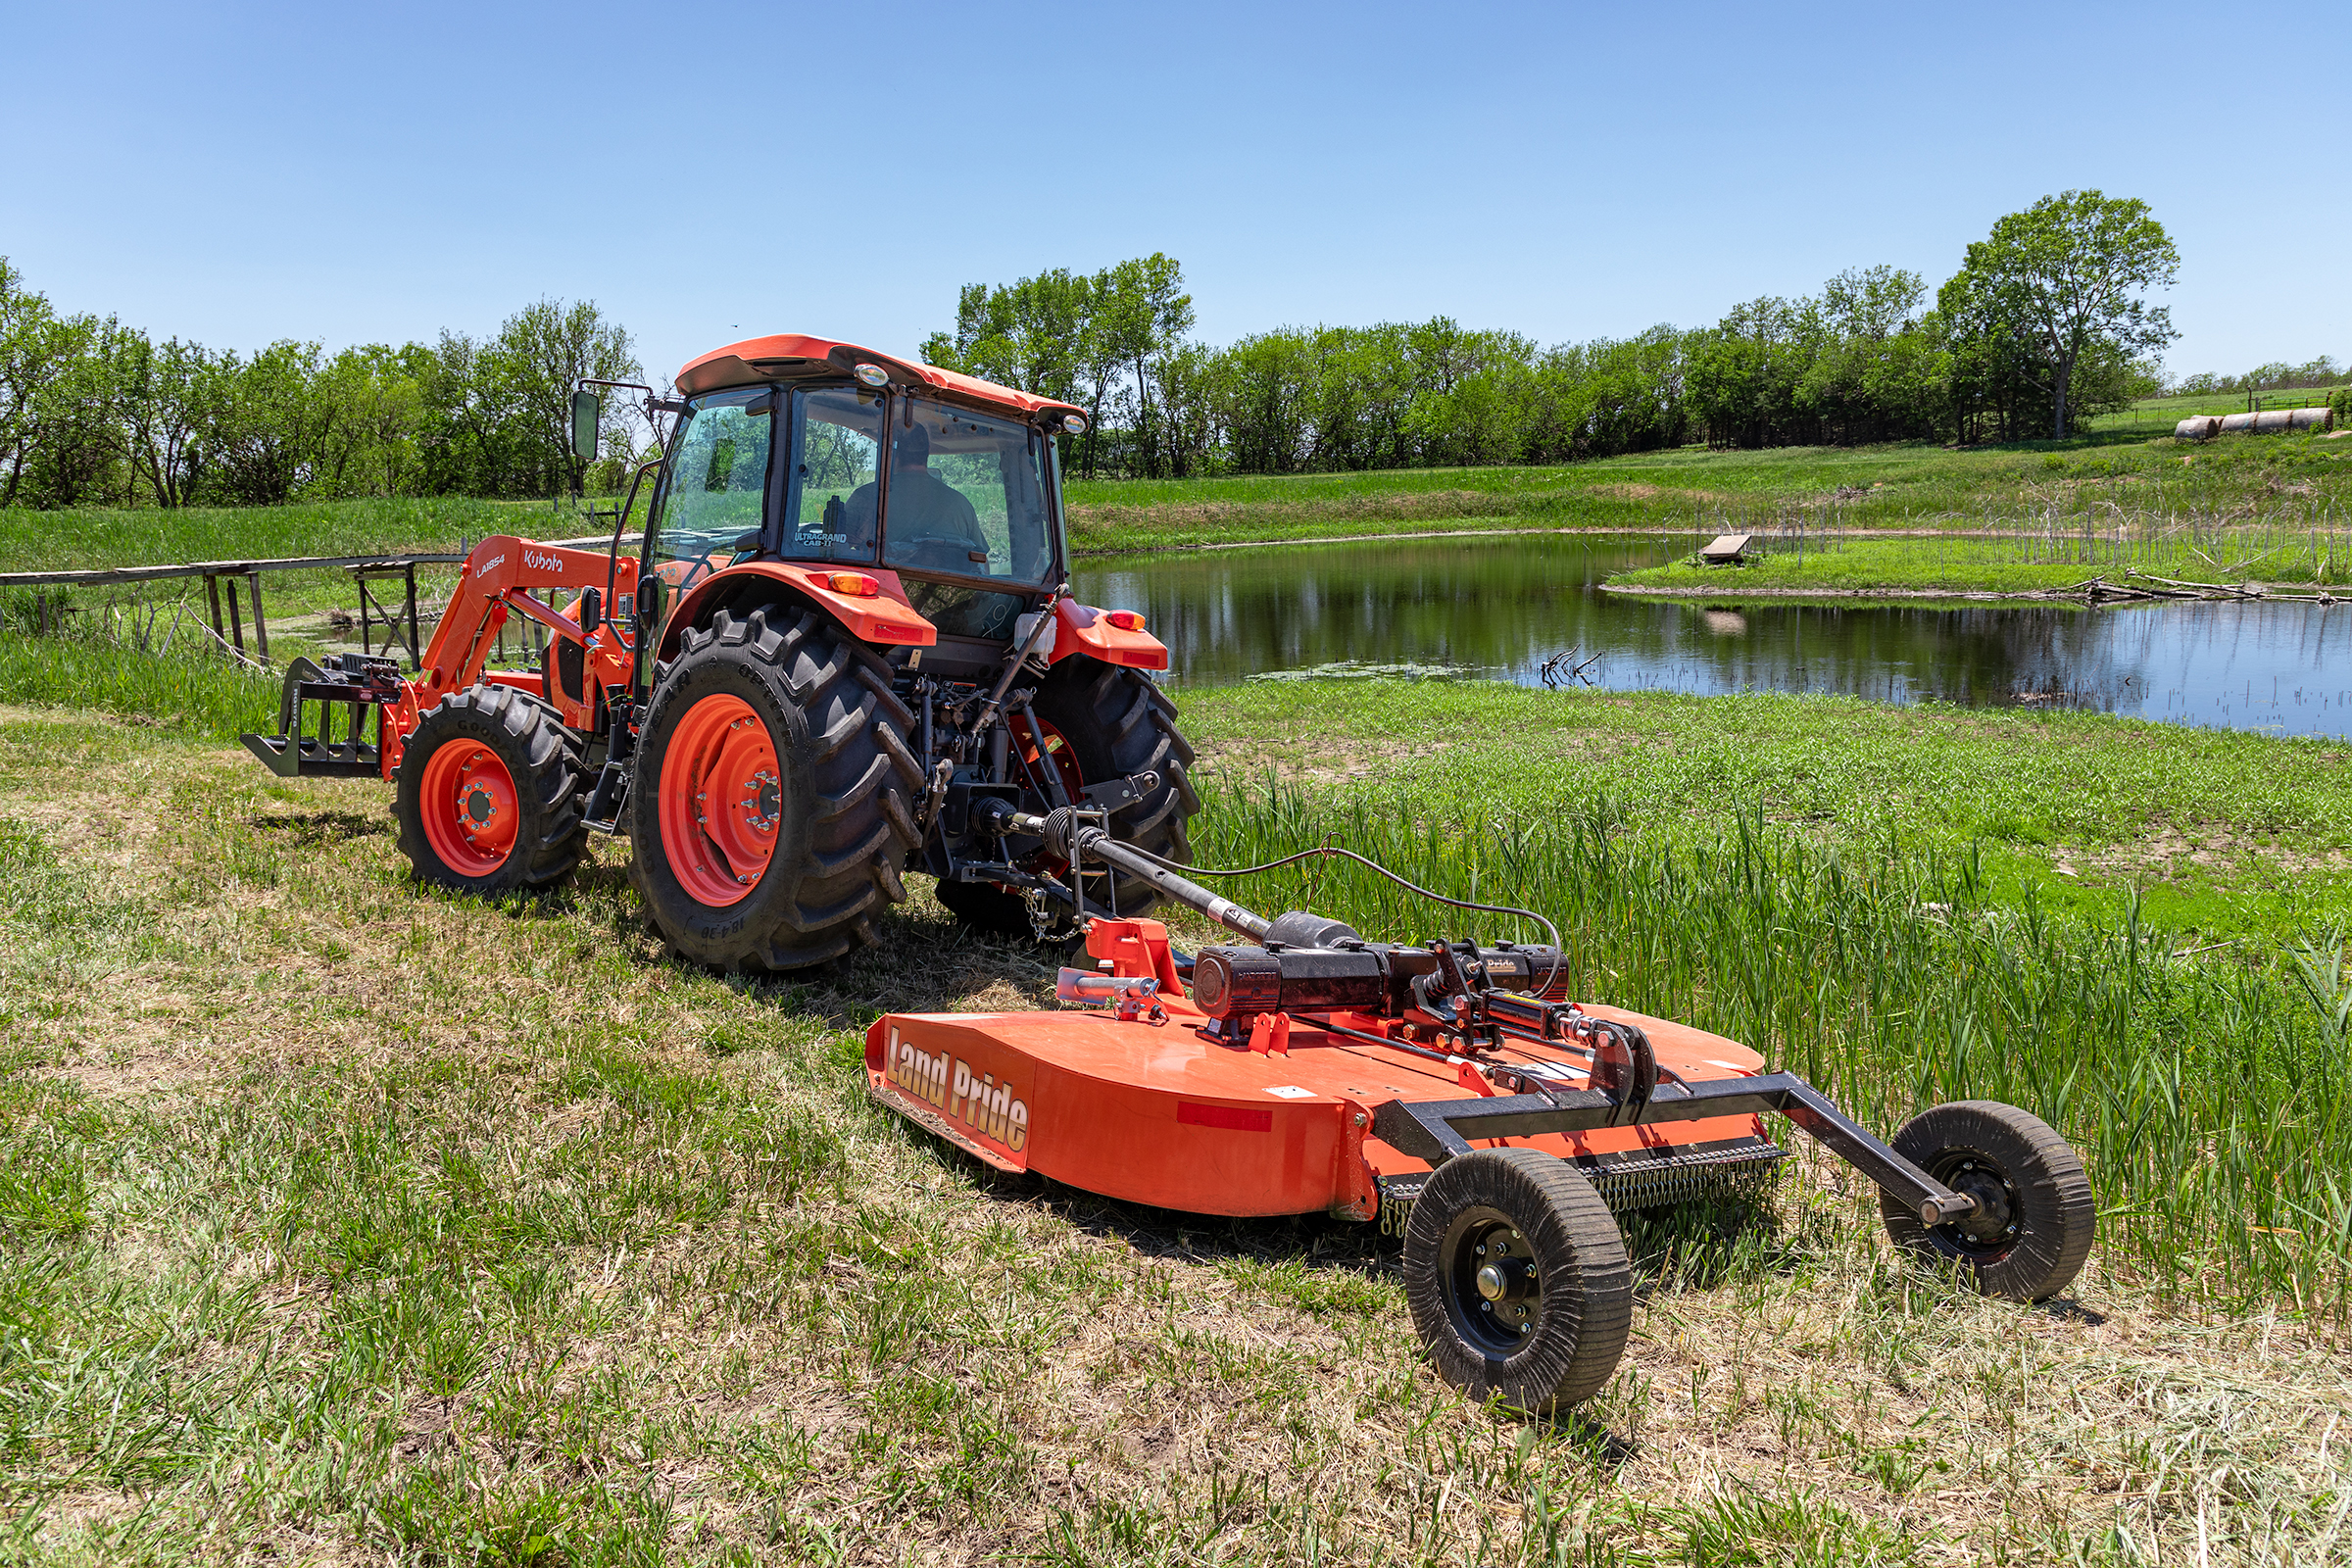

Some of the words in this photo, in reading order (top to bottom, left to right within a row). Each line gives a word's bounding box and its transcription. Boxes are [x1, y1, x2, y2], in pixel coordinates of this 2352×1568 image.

[795, 532, 847, 543] ULTRAGRAND
[476, 554, 505, 578] LA1854
[524, 550, 563, 572] Kubota
[886, 1025, 950, 1110] Land
[949, 1056, 1028, 1152] Pride
